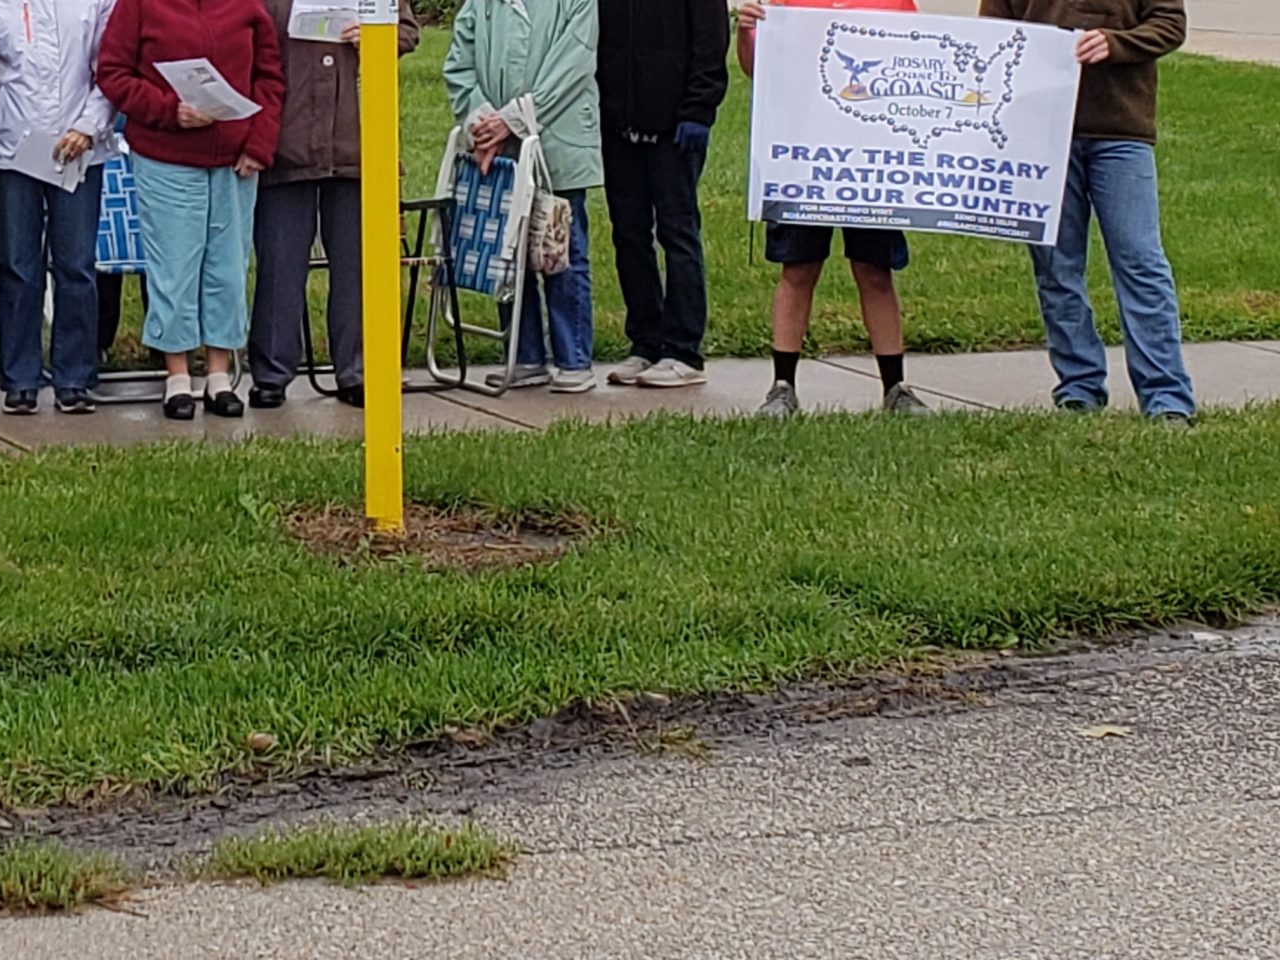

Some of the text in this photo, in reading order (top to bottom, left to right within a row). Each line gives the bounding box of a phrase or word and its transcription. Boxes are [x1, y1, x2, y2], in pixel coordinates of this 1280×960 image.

[893, 56, 946, 72] ROSARY
[869, 77, 964, 100] COAST
[887, 102, 953, 119] October 7
[772, 144, 1050, 179] PRAY THE ROSARY
[812, 166, 1014, 195] NATIONWIDE
[764, 183, 1051, 218] FOR OUR COUNTRY
